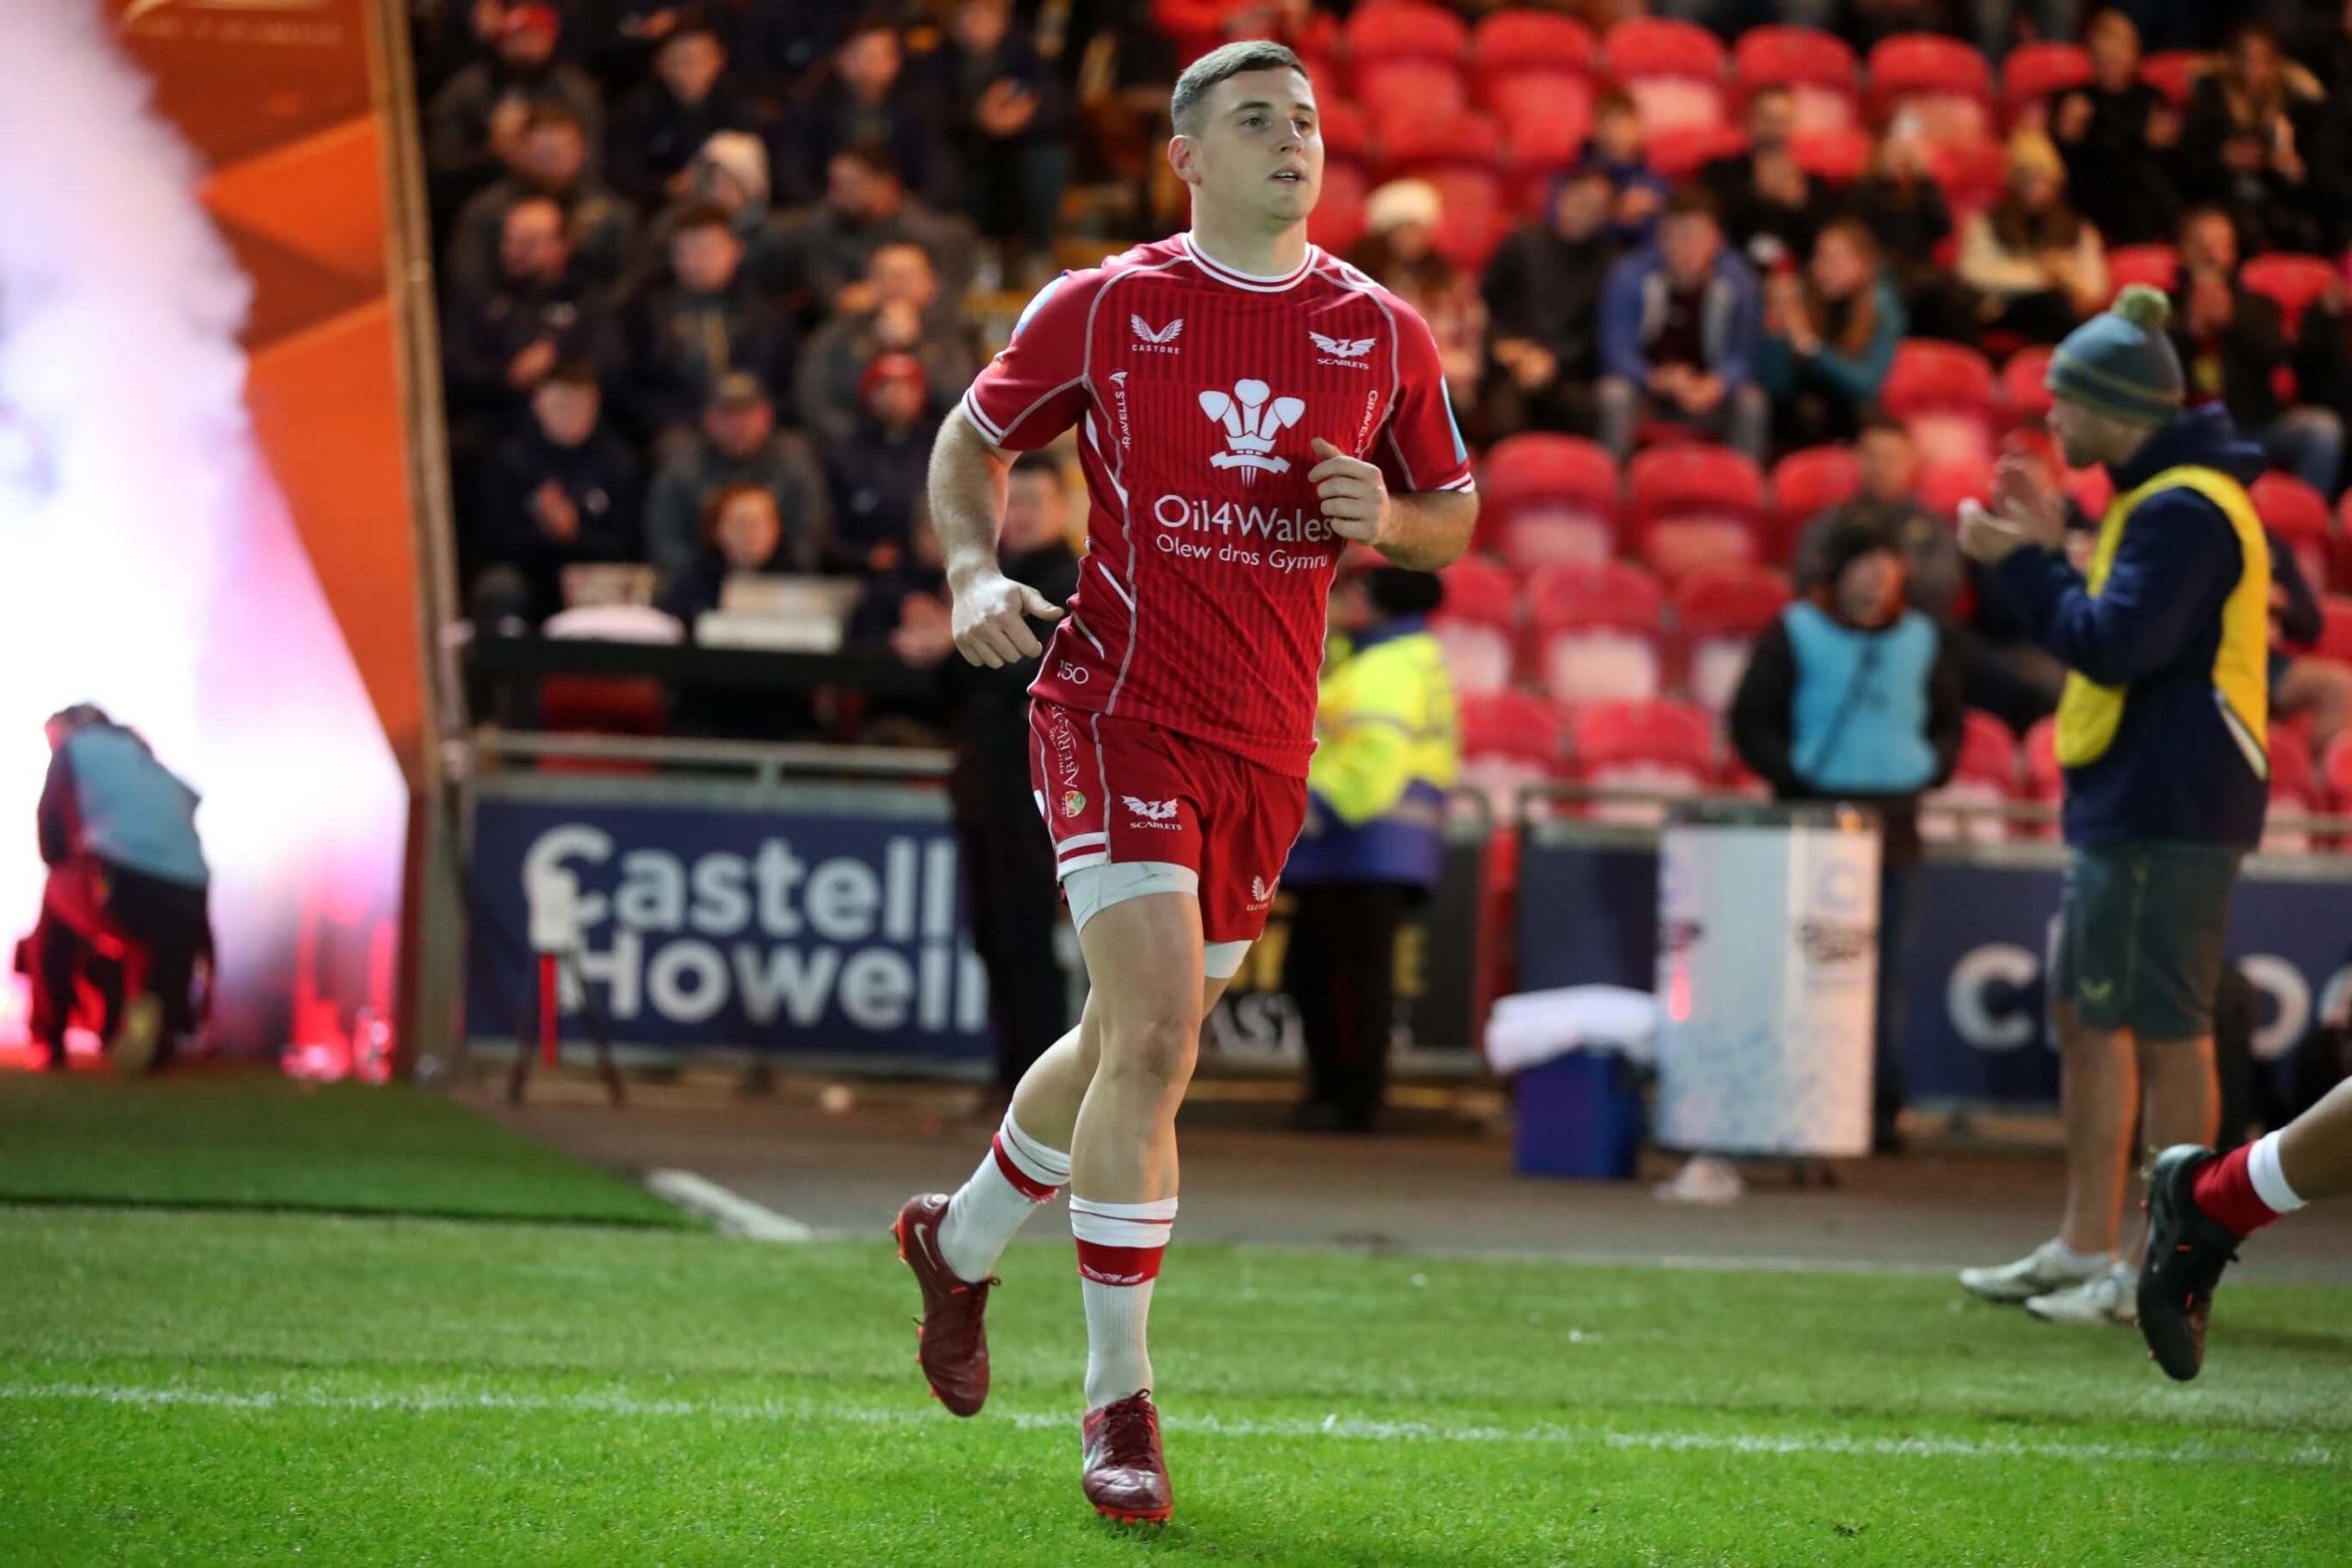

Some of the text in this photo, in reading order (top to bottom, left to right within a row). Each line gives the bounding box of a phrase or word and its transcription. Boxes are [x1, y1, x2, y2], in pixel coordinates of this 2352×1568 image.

[1131, 344, 1181, 355] CASTORE
[1317, 357, 1370, 370] SCARLETS
[1153, 494, 1332, 543] Oil4Wales
[1156, 533, 1329, 574] Olew dros Gymru
[1130, 821, 1182, 830] SCARLETS
[523, 824, 957, 942] Castell
[554, 926, 989, 1032] Howell
